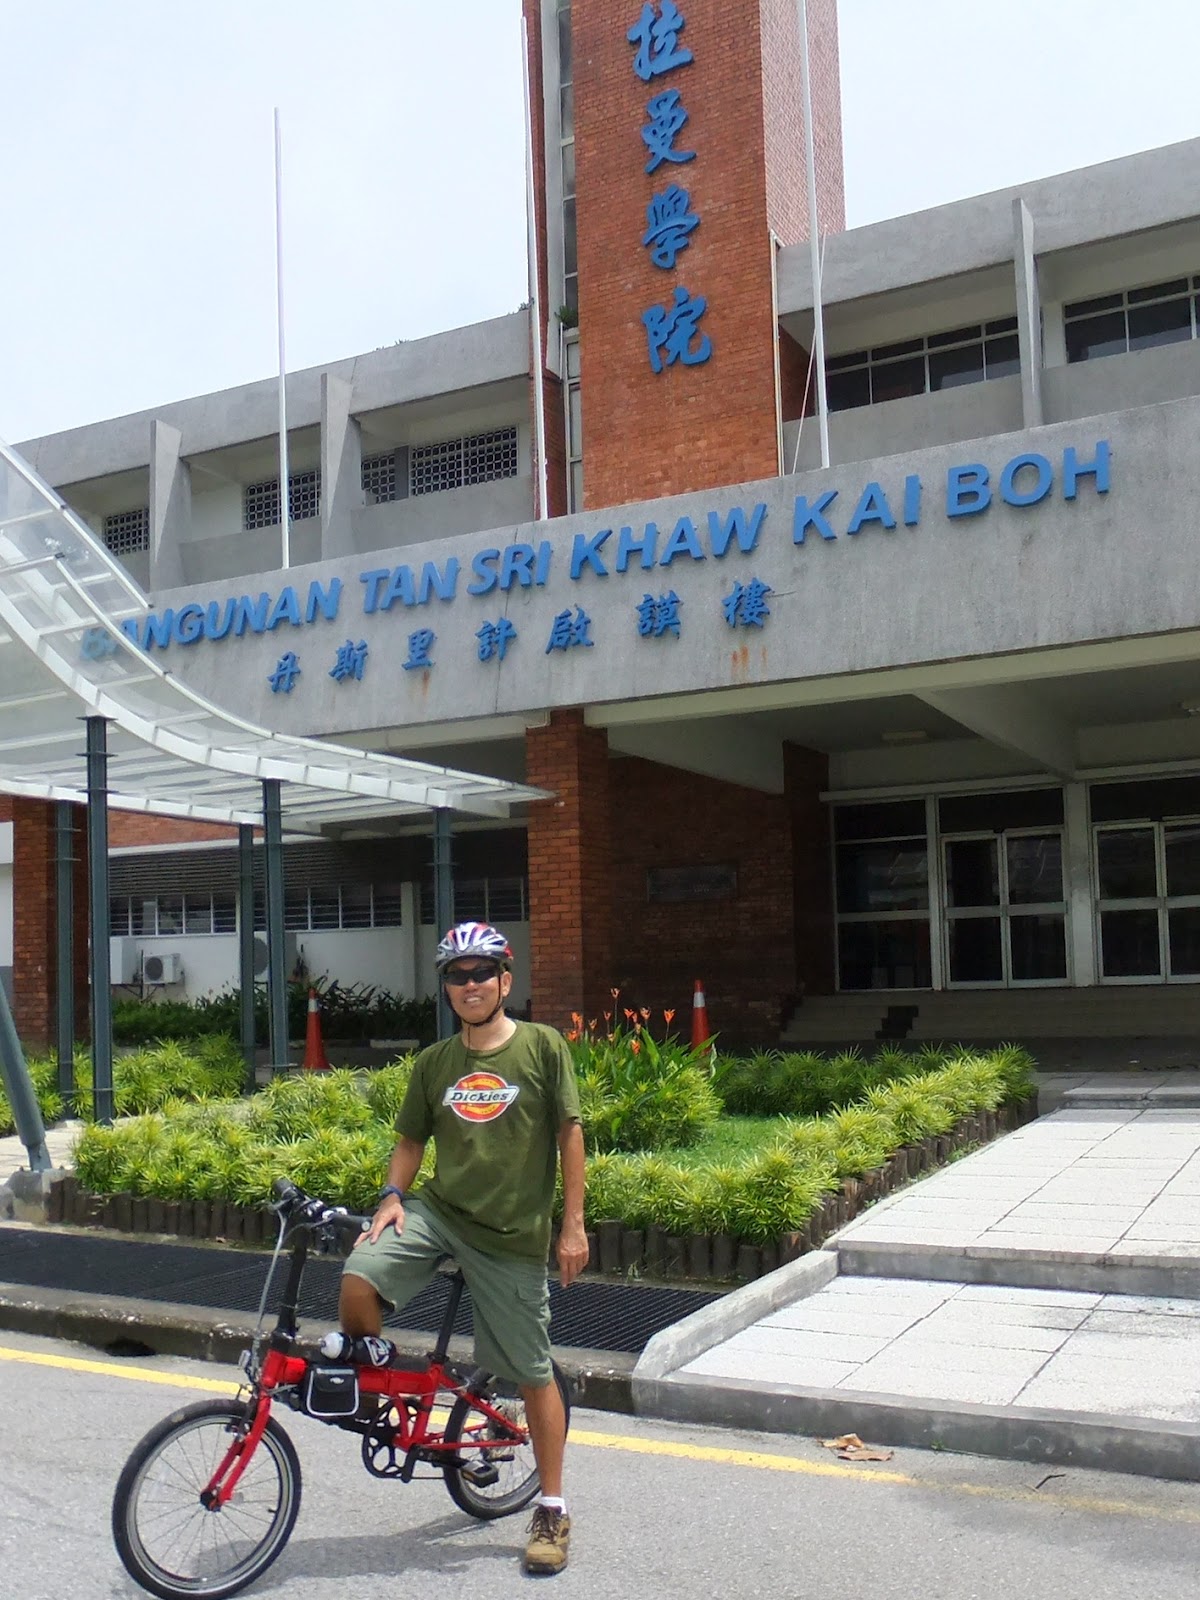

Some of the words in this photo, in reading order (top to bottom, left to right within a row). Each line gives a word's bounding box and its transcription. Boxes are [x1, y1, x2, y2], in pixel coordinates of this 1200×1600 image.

[360, 557, 460, 614] TAN
[467, 540, 553, 595] SRI
[569, 503, 767, 580] KHAW
[792, 474, 922, 545] KAI
[946, 440, 1112, 519] BOH
[450, 1092, 509, 1102] Dickies
